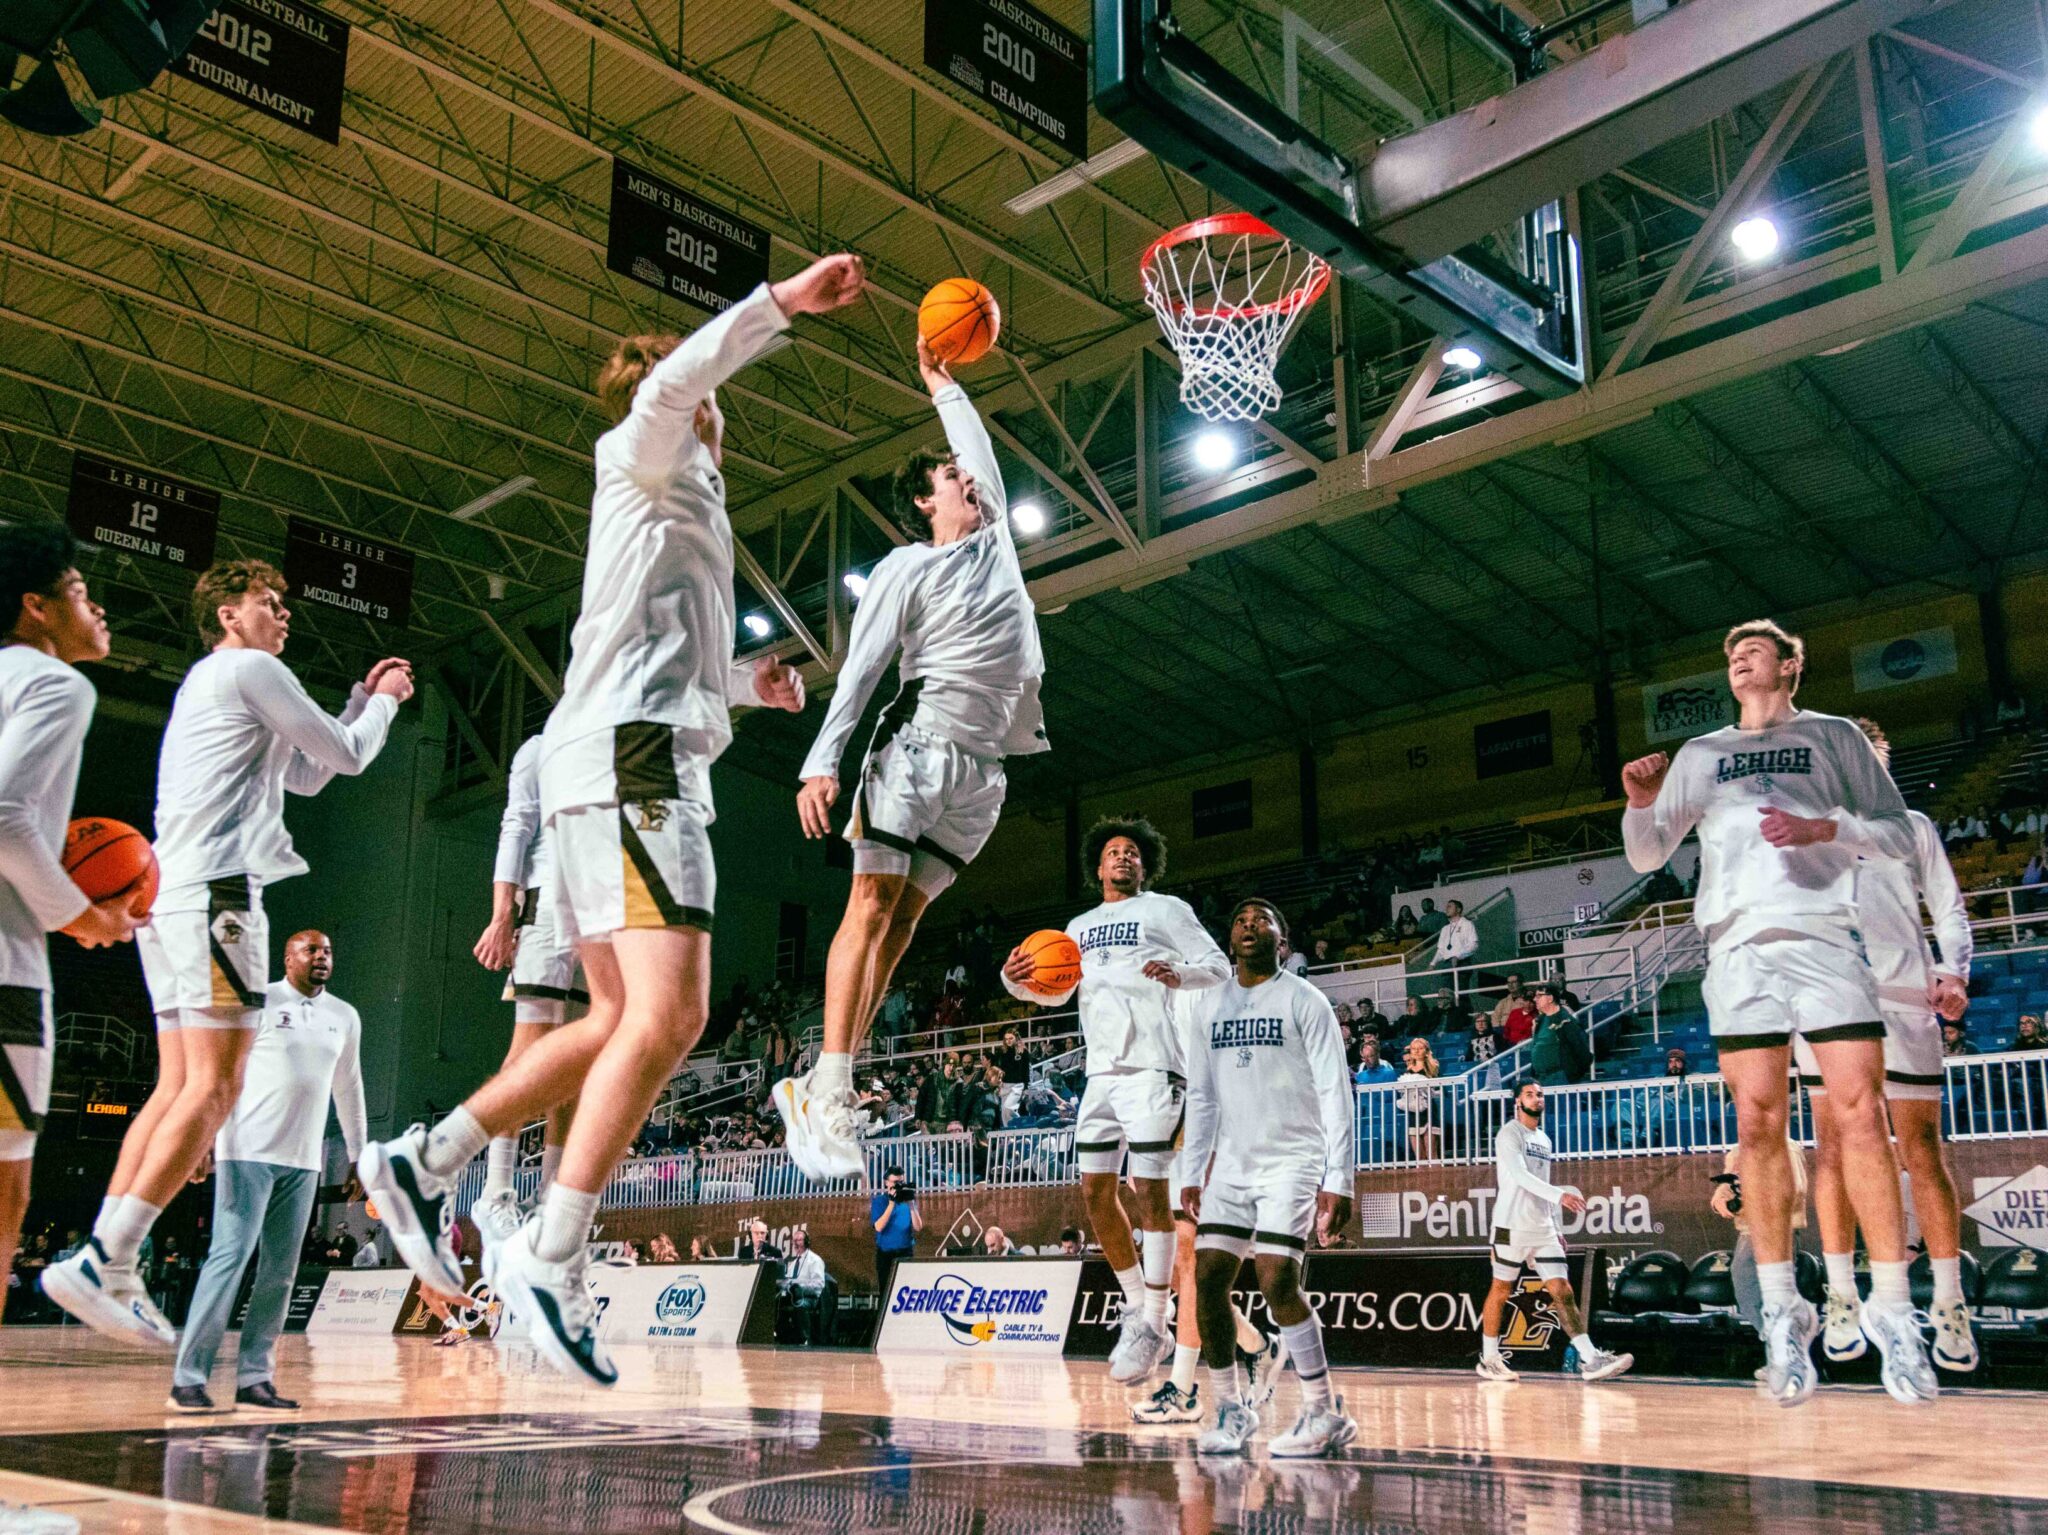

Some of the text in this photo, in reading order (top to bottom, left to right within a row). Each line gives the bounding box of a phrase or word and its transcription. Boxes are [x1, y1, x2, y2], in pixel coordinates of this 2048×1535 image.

[244, 0, 329, 43] KETBALL
[197, 8, 273, 67] 2012
[983, 22, 1036, 83] 2010
[187, 53, 316, 125] TOURNAMENT
[990, 80, 1066, 140] CHAMPIONS
[627, 175, 757, 250] MEN'S BASKETBALL
[665, 225, 719, 275] 2012
[110, 469, 186, 502] LEHIGH
[129, 501, 159, 533] 12
[94, 525, 163, 557] QUEENAN
[319, 532, 386, 562] LEHIGH
[341, 562, 358, 590] 3
[303, 584, 389, 619] MCCOLLUM '13
[1653, 701, 1721, 721] PATRIOT
[1653, 708, 1726, 733] LEAGUE
[1406, 745, 1429, 770] 15
[1479, 732, 1547, 757] LAFAYETTE
[1716, 747, 1812, 778] LEHIGH
[1578, 904, 1596, 920] EXIT
[1080, 921, 1140, 949] LEHIGH
[1211, 1017, 1284, 1043] LEHIGH
[86, 1103, 128, 1115] LEHIGH
[1992, 1210, 2048, 1229] WAT
[665, 1288, 698, 1308] FOX
[891, 1285, 1049, 1316] SERVICE ELECTRIC
[662, 1308, 693, 1317] SPORTS
[686, 1327, 697, 1337] AM
[997, 1332, 1061, 1343] COMMUNICATIONS
[1003, 1323, 1044, 1332] CABLE TV &
